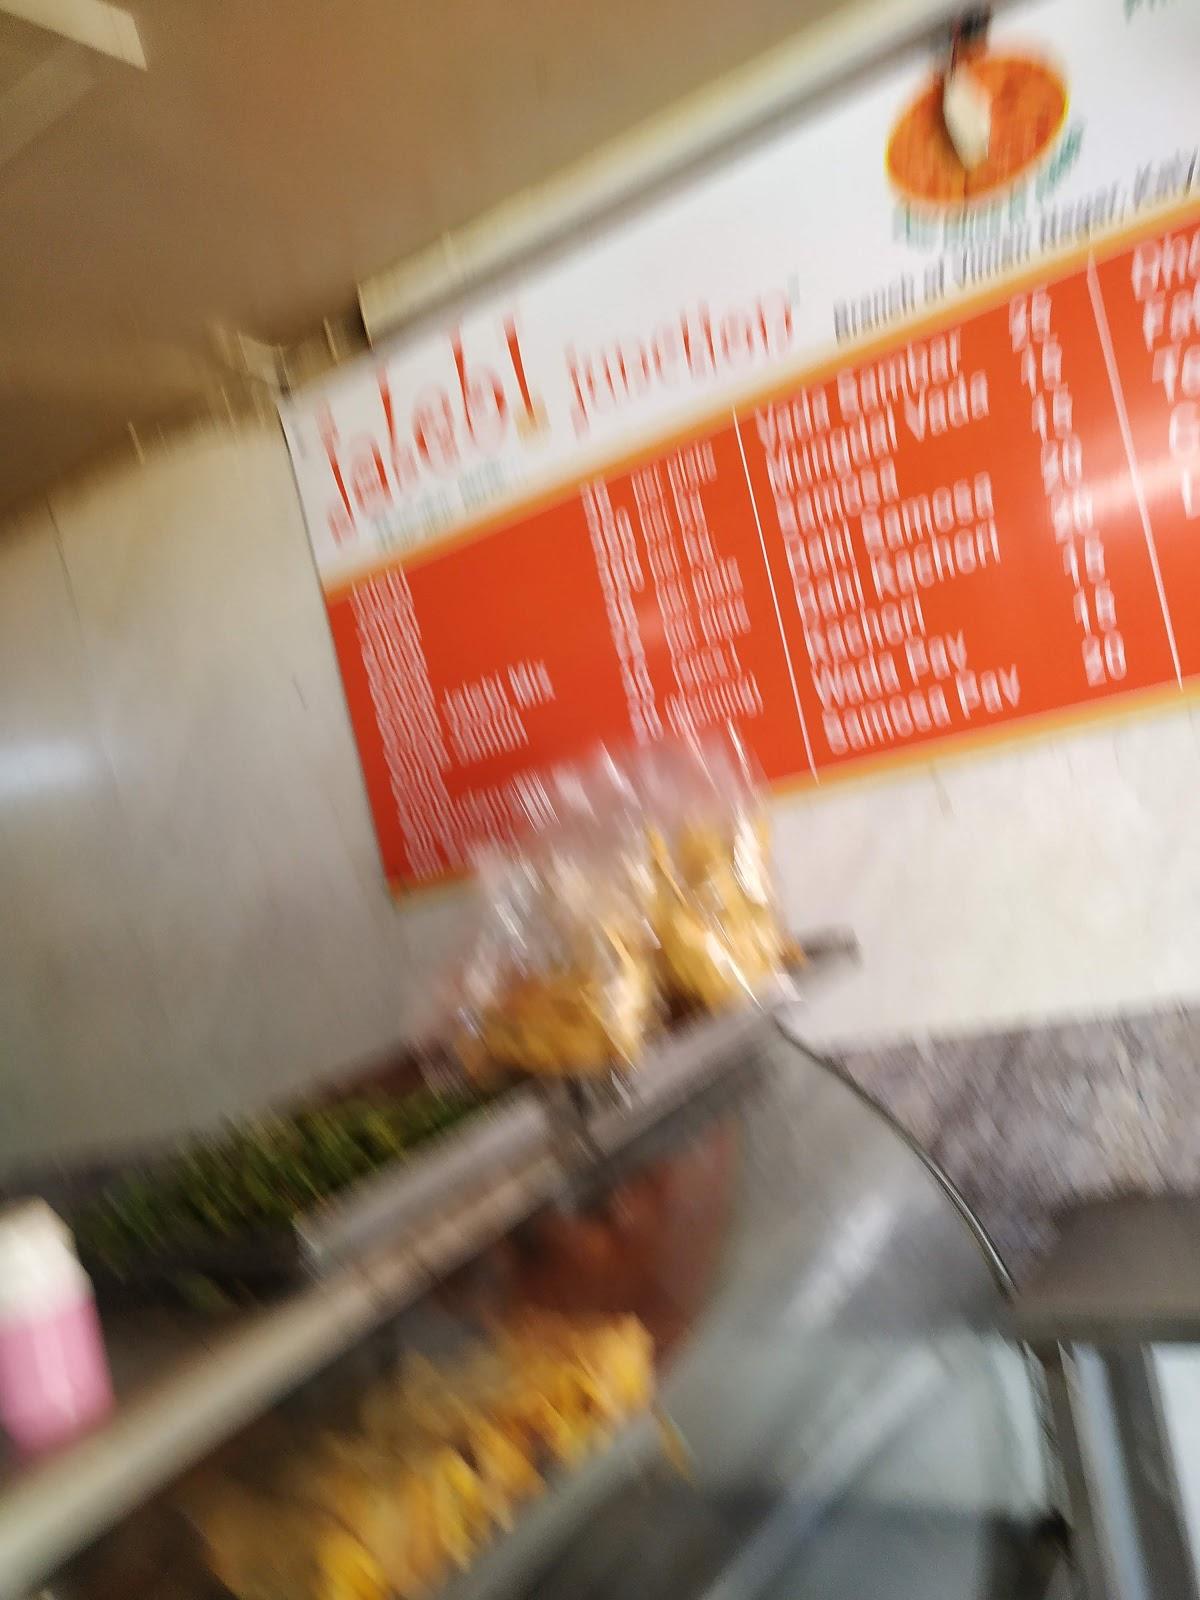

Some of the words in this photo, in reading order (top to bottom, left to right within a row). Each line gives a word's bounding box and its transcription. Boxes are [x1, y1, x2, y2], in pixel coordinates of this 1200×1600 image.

[870, 515, 1002, 600] Kachori
[904, 630, 968, 685] Pav
[955, 662, 1021, 720] Pav
